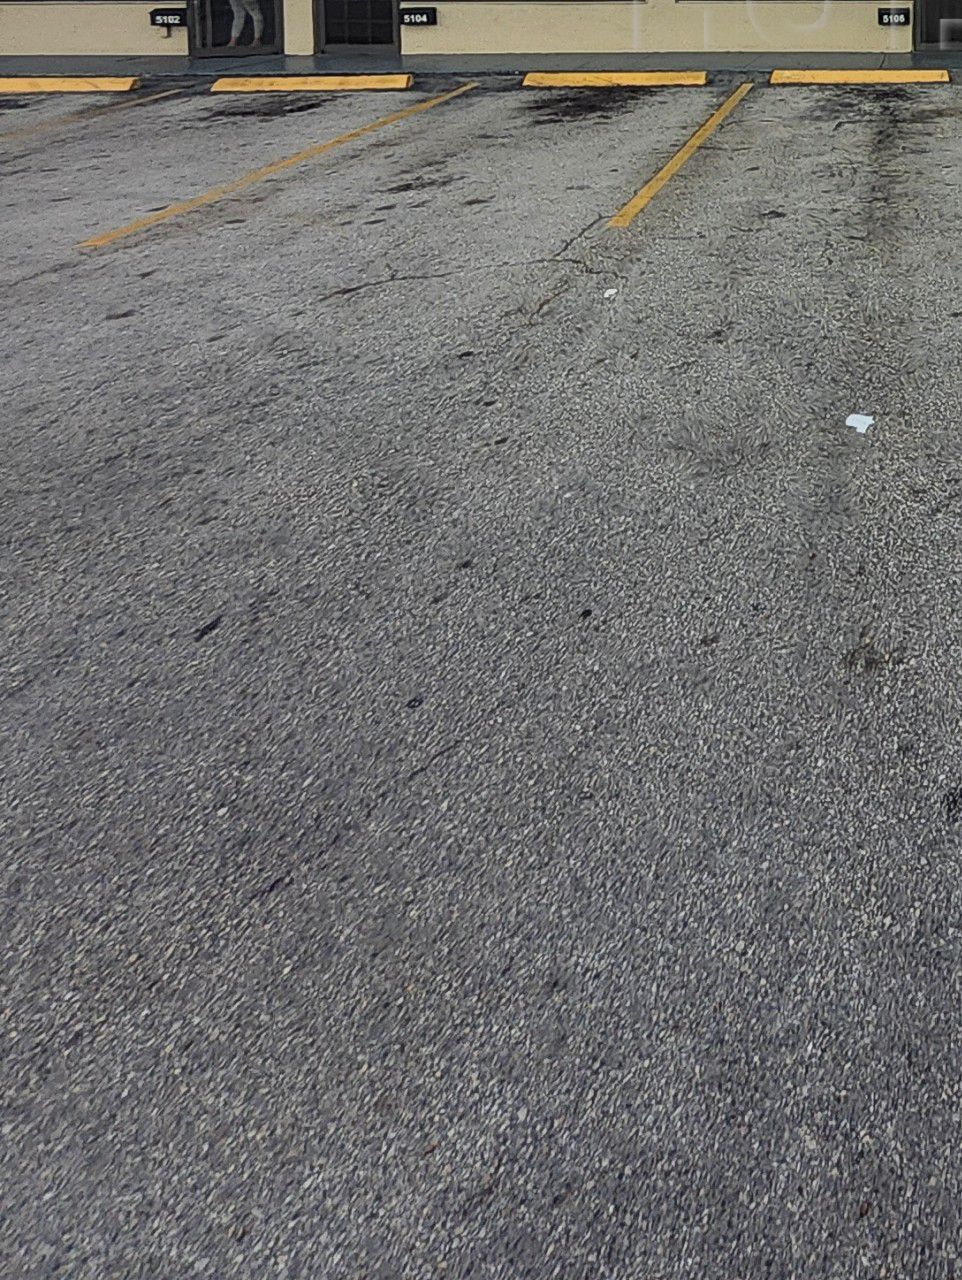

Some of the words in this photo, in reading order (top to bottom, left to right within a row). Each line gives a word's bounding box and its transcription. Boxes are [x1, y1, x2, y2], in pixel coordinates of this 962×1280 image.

[155, 15, 181, 24] 5102
[403, 13, 428, 23] 5104
[882, 13, 906, 23] 5106
